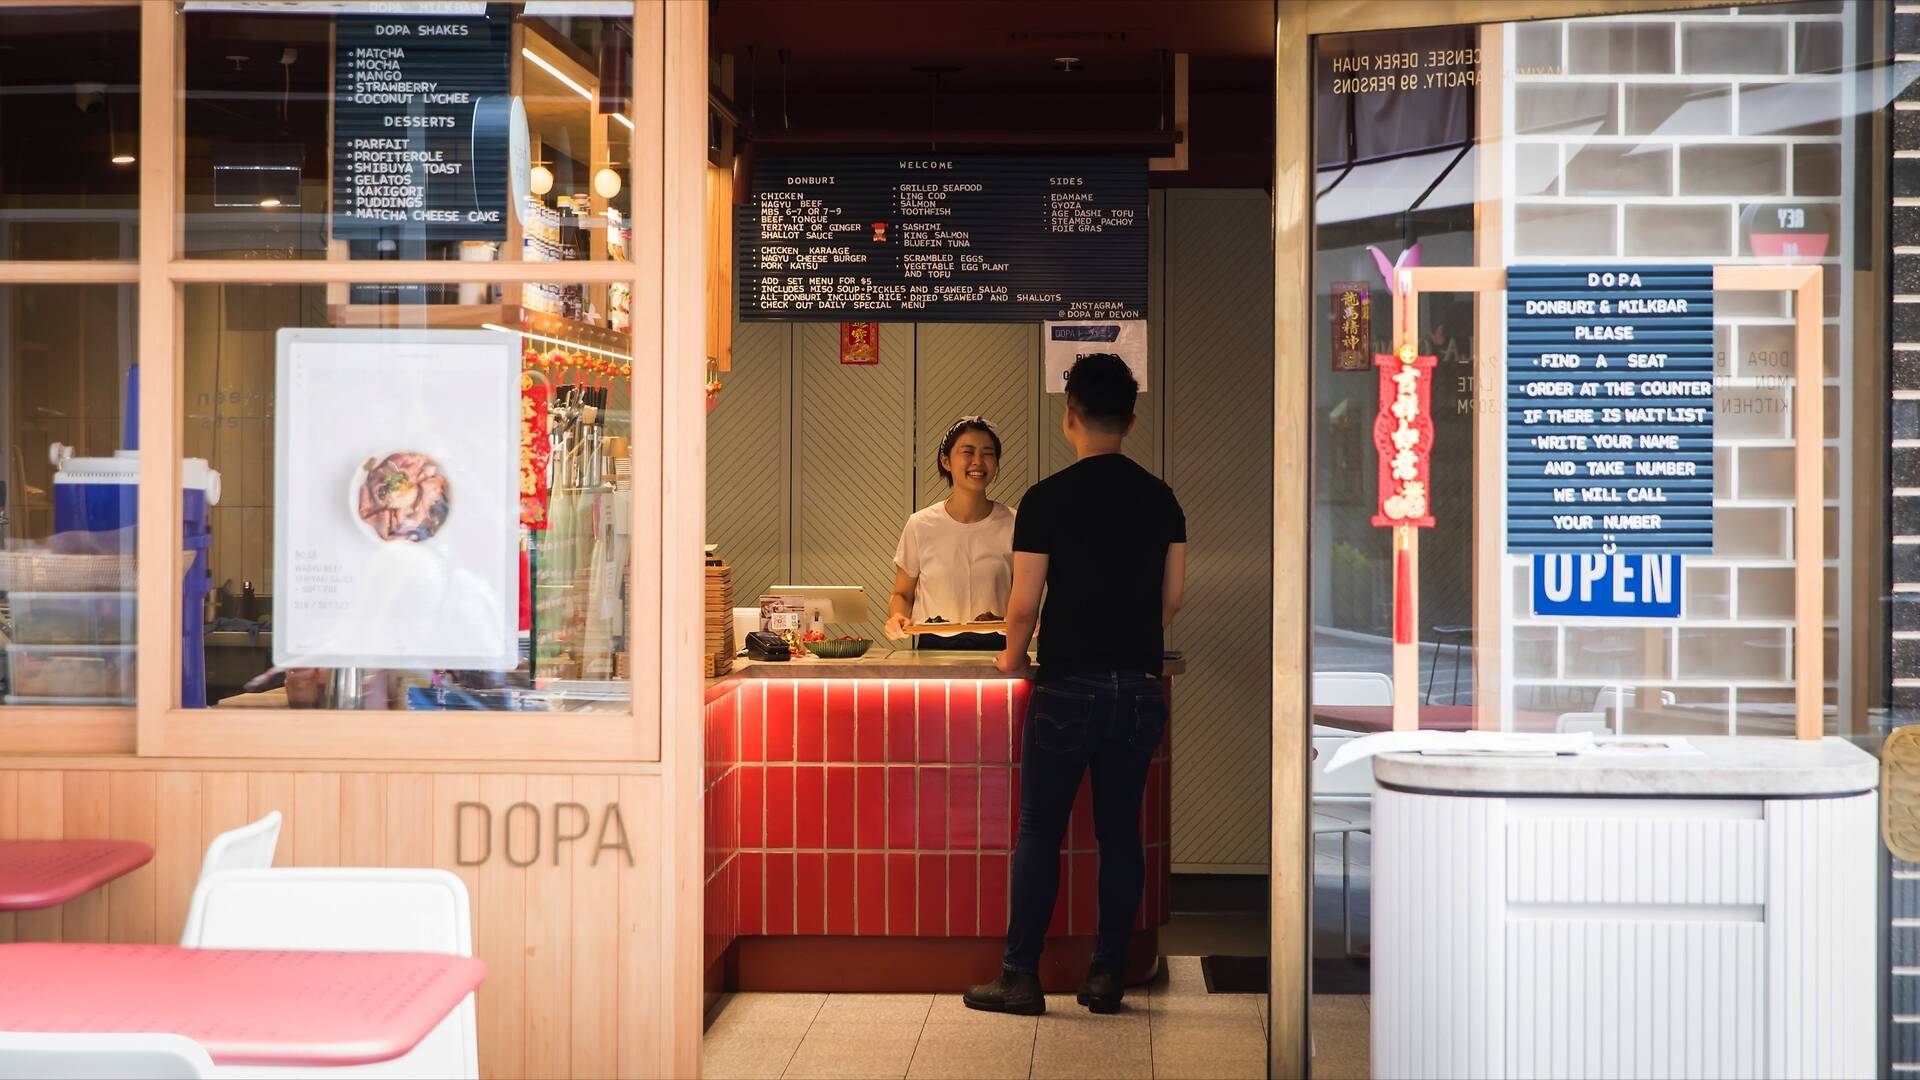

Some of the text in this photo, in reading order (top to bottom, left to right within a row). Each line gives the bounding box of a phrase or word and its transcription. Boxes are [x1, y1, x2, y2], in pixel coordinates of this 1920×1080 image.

[376, 25, 469, 36] DOPA SHAKES
[356, 48, 405, 59] MATCHA
[356, 60, 400, 70] MOCHA
[356, 71, 402, 81] MANGO
[356, 82, 438, 92] STRAWBERRY
[355, 93, 470, 104] COCONUT LYCHEE
[384, 116, 456, 127] DESSERTS
[355, 139, 410, 150] PARFAIT
[355, 151, 444, 162] PROFITEROLE
[355, 163, 462, 174] SHIBUYA TOAST
[899, 161, 953, 169] WELCOME
[355, 174, 412, 185] GELATOS
[787, 176, 835, 185] DONBURI
[1049, 177, 1084, 185] SIDES
[356, 186, 424, 197] KAKIGORI
[899, 184, 983, 192] GRILLED SEAFOOD
[761, 192, 804, 200] CHICKEN
[900, 192, 946, 200] LING COD
[1051, 193, 1094, 201] EDAMAME
[356, 198, 423, 208] PUDDINGS
[800, 200, 823, 208] BEEF
[900, 200, 936, 208] SALMON
[1051, 201, 1082, 209] GYOZA
[356, 209, 500, 222] MATCHA CHEESE CAKE
[761, 208, 780, 216] MBS
[807, 208, 820, 216] OR
[901, 208, 951, 216] TOOTHFISH
[1074, 209, 1102, 217] DASHI
[1111, 210, 1134, 218] TOFU
[1051, 217, 1133, 226] STEAMED PACHOY
[829, 223, 861, 231] GINGER
[902, 223, 941, 231] SASHIMI
[1078, 225, 1102, 233] GRAS
[806, 232, 833, 240] SAUCE
[904, 231, 969, 239] KING SALMON
[904, 239, 970, 248] BLUEFIN TUNA
[761, 247, 850, 255] CHICKEN KARAAGE
[796, 254, 828, 263] CHEESE
[833, 255, 867, 263] BURGER
[903, 254, 984, 263] SCRAMBLED EGGS
[761, 262, 819, 270] PORK KATSU
[904, 262, 1009, 271] VEGETABLE EGG PLANT
[904, 270, 951, 279] AND TOFU
[761, 277, 779, 285] ADD
[787, 277, 803, 285] SET
[809, 277, 834, 285] MENU
[839, 277, 856, 285] FOR
[1588, 273, 1642, 287] DOPA
[910, 286, 928, 294] AND
[934, 286, 973, 294] SEAWEED
[978, 286, 1008, 294] SALAD
[760, 293, 777, 301] ALL
[783, 293, 822, 301] DONBURI
[827, 293, 871, 301] INCLUDES
[878, 293, 902, 301] RICE
[910, 294, 938, 302] DRIED
[990, 294, 1009, 302] AND
[1017, 294, 1062, 302] SHALLOTS
[760, 301, 789, 309] CHECK
[795, 302, 814, 310] OUT
[818, 301, 846, 309] DAILY
[1070, 302, 1124, 310] INSTAGRAM
[1526, 299, 1687, 315] DONBURI & MILKBAR
[1575, 326, 1634, 340] PLEASE
[1541, 354, 1668, 368] FIND A SEAT
[1526, 381, 1712, 397] ORDER AT THE COUNTER
[1523, 409, 1543, 424] IF
[1547, 409, 1594, 423] THERE
[1601, 408, 1621, 422] IS
[1538, 435, 1679, 450] WRITE YOUR NAME
[1544, 461, 1696, 476] AND TAKE NUMBER
[1553, 488, 1667, 502] WE WILL CALL
[1553, 515, 1662, 530] YOUR NUMBER
[1544, 554, 1672, 604] OPEN
[456, 801, 634, 868] DOPA
